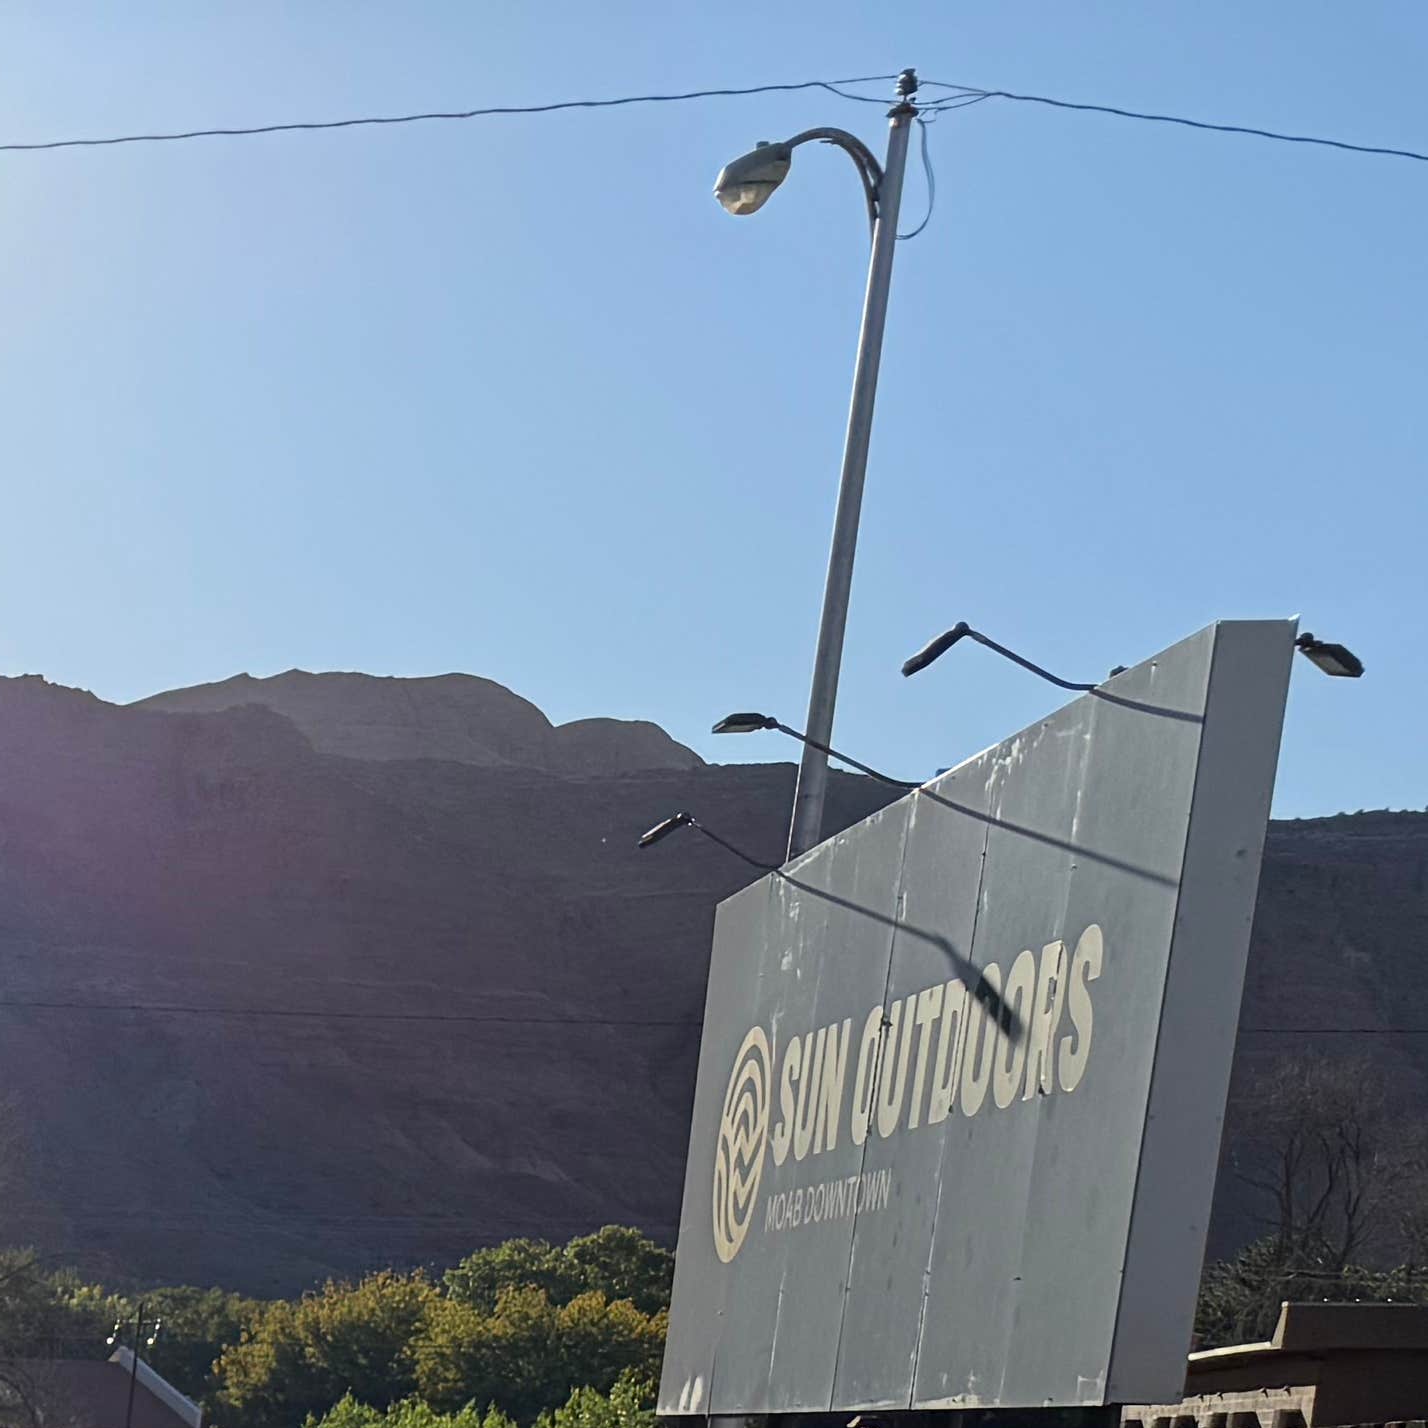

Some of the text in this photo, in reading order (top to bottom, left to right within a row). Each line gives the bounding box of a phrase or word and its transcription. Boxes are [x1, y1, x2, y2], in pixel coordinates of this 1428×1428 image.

[771, 923, 1104, 1166] SUN OUTDOORS
[764, 1168, 892, 1232] MOAB DOWNTOWN
